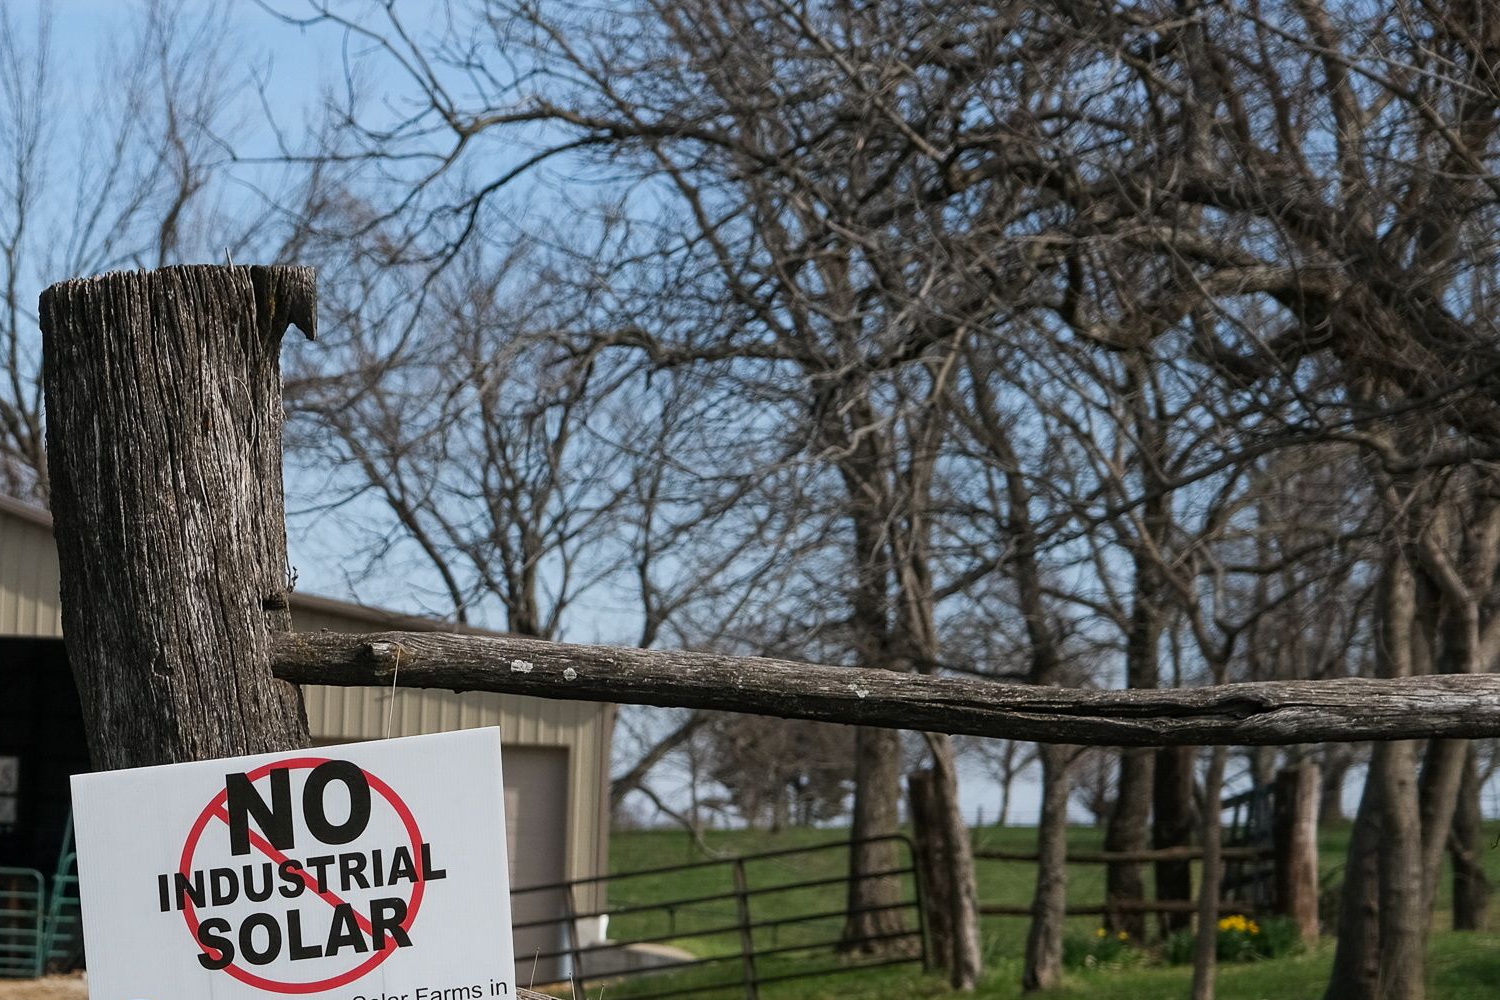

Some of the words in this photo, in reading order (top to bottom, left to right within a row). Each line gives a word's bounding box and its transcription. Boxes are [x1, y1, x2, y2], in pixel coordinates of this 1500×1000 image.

[225, 759, 372, 856] NO
[158, 843, 447, 912] INDUSTRIAL
[197, 897, 413, 971] SOLAR
[490, 979, 508, 997] in
